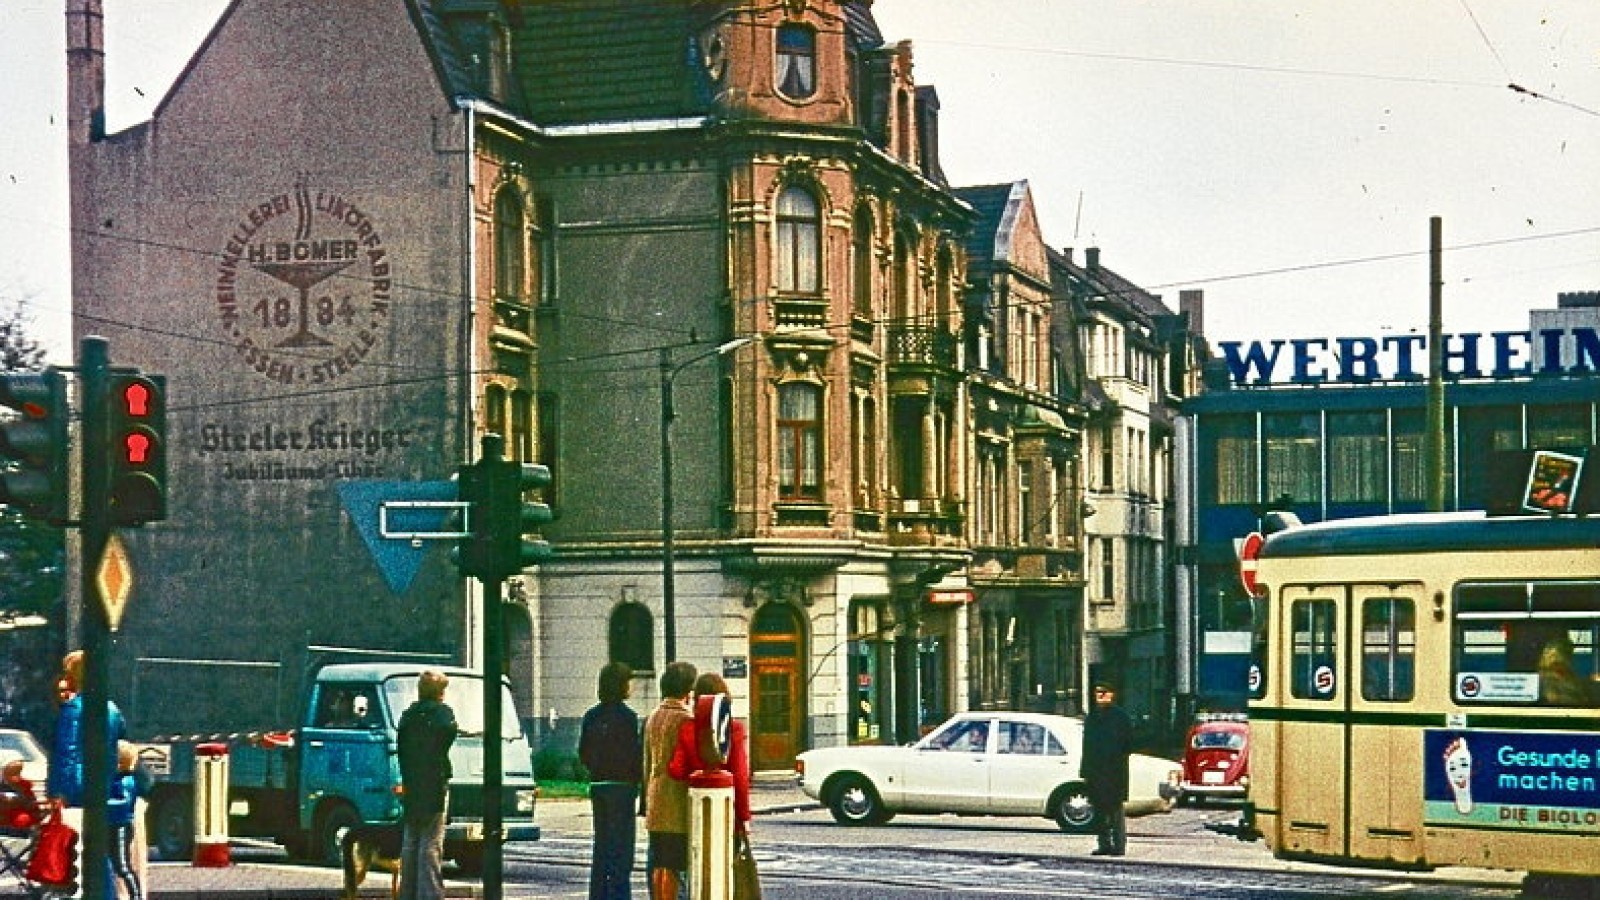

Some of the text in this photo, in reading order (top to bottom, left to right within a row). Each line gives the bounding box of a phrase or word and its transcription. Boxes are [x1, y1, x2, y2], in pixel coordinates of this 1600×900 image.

[253, 298, 291, 328] 18
[1498, 745, 1590, 769] Gesunde
[1498, 771, 1595, 791] machen
[1500, 806, 1527, 822] DIE
